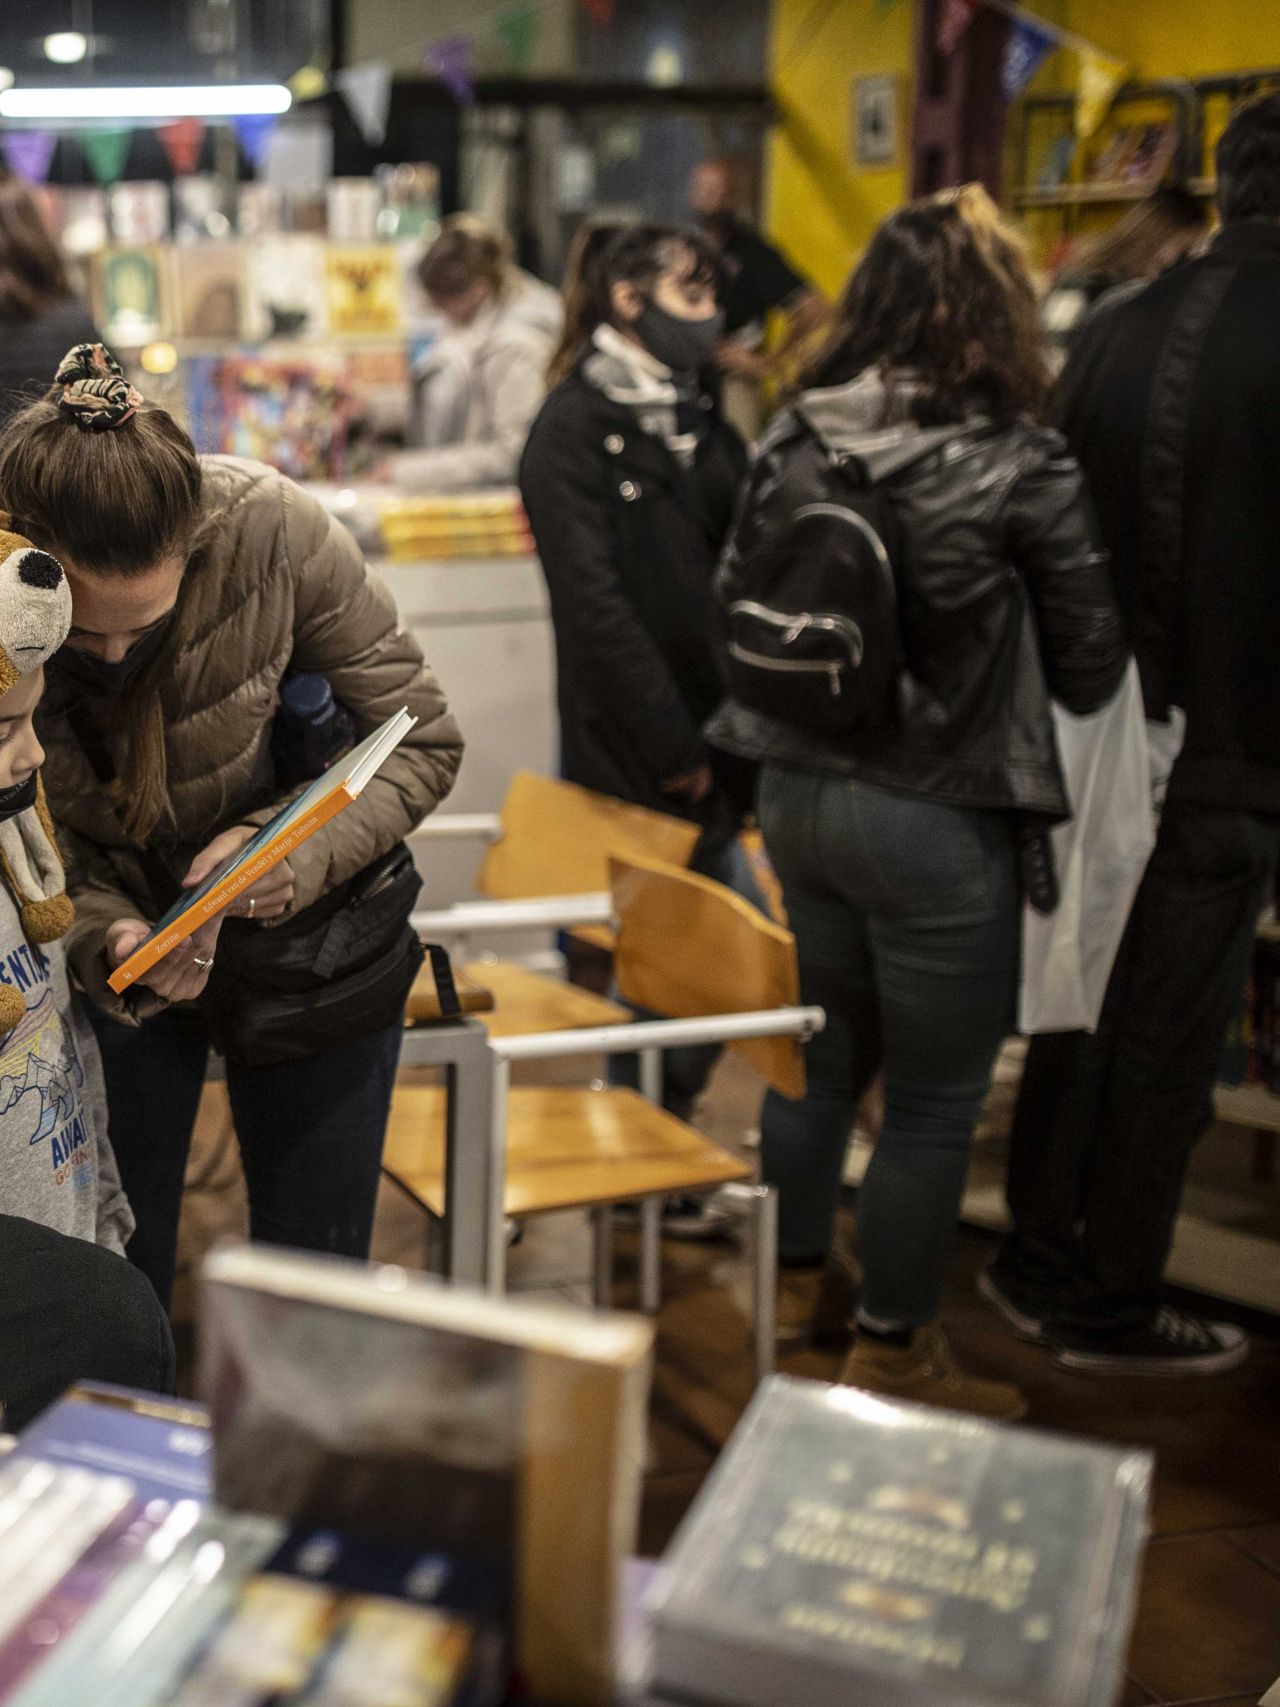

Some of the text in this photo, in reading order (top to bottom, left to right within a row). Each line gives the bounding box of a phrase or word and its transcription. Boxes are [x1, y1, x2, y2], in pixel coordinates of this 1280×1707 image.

[202, 889, 228, 913] Edward
[227, 879, 240, 893] van
[245, 855, 269, 878] Vendel
[292, 815, 319, 839] Tolman
[155, 931, 180, 954] Zorrito
[51, 1105, 88, 1169] AWAI
